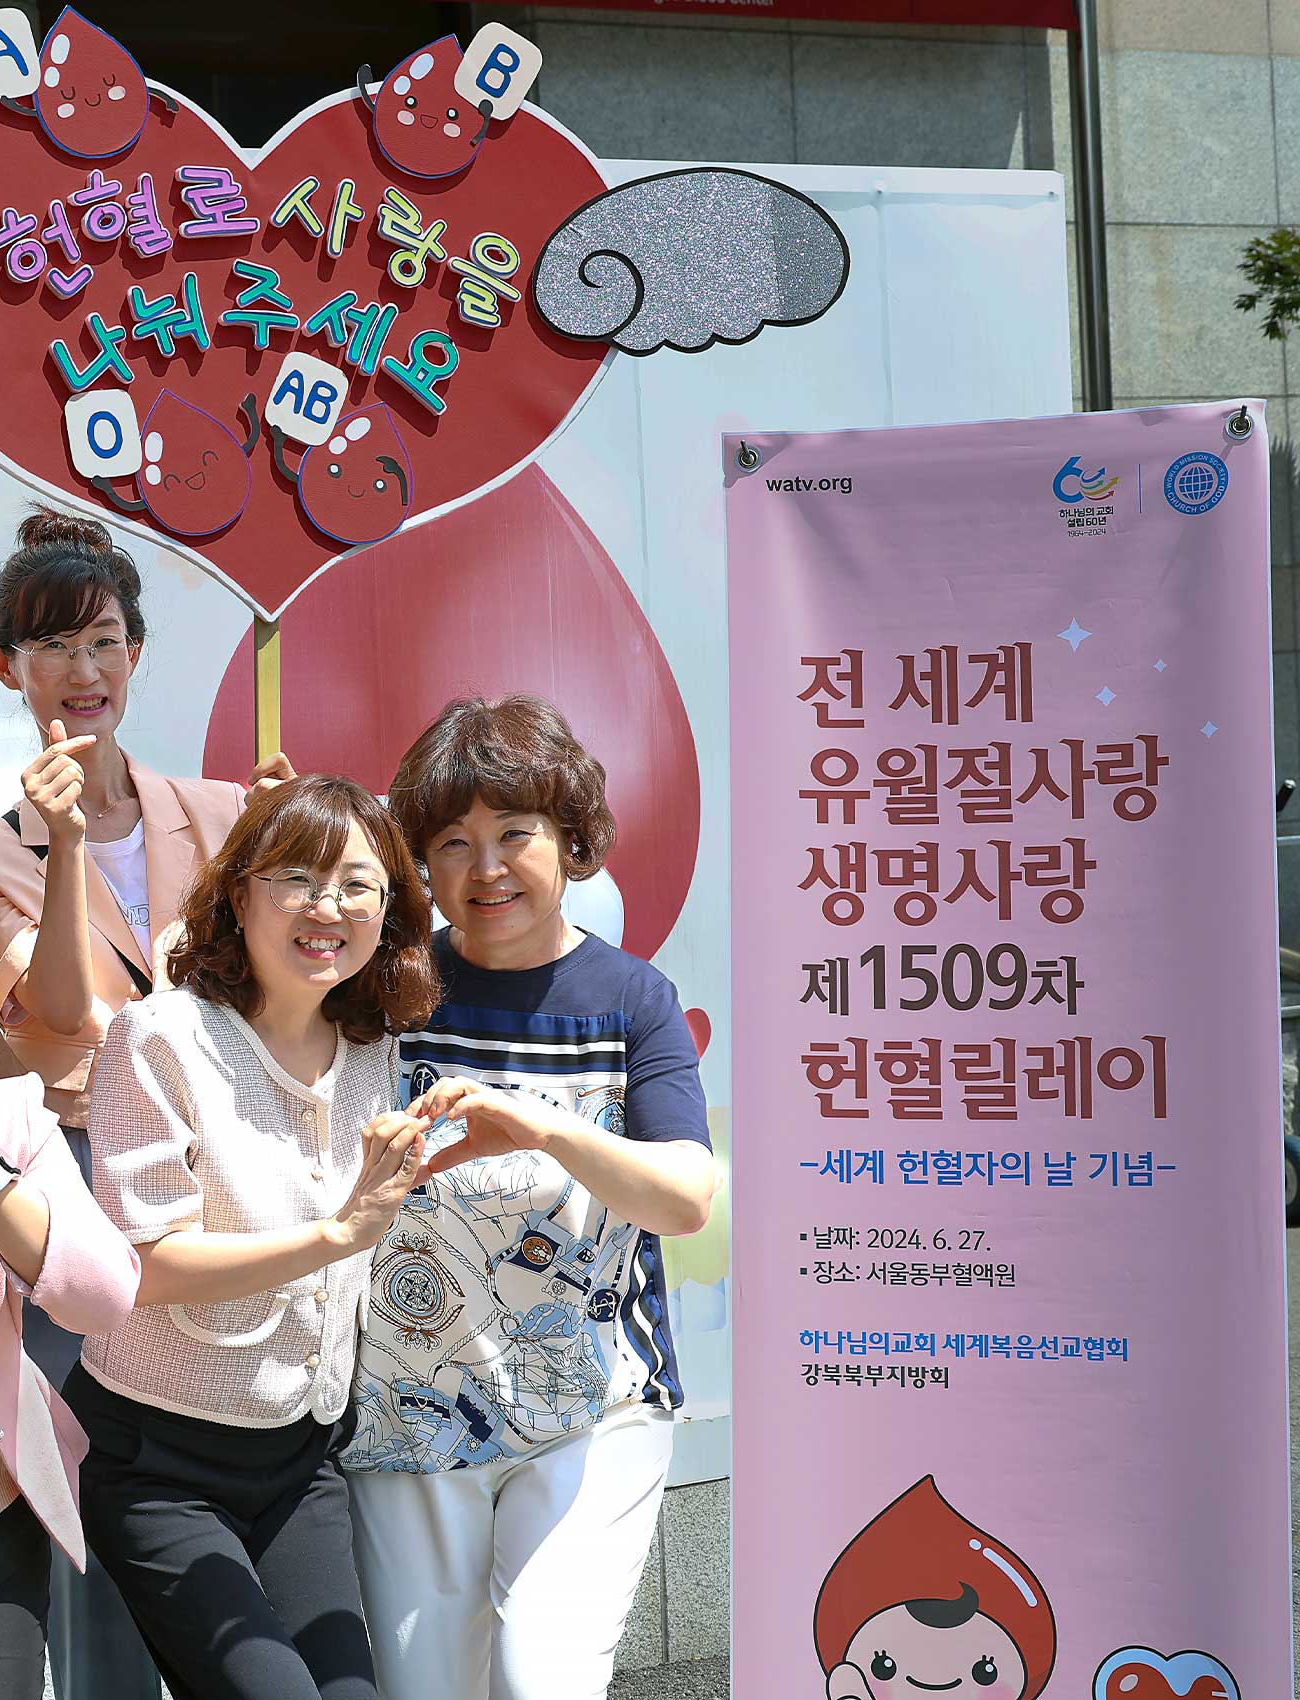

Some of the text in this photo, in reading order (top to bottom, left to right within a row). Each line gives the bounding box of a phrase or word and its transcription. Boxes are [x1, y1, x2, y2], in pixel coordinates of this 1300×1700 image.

[477, 43, 521, 98] B
[271, 176, 522, 329] 사랑을
[273, 369, 340, 425] AB
[765, 476, 852, 494] watv.org
[1165, 454, 1227, 489] WORLD MISSION SOCIETY
[1058, 505, 1114, 518] 하나님의 교회
[1167, 485, 1225, 513] CHURCH OF GOD
[797, 641, 1034, 729] 전 세계
[798, 734, 1171, 826] 유월절사랑
[797, 837, 1097, 927] 생명사랑
[799, 943, 1085, 1016] 제1509차
[800, 1036, 1168, 1121] 헌혈릴레이
[897, 1149, 1031, 1187] 헌혈자의
[1043, 1151, 1077, 1187] 날
[813, 1226, 991, 1252] 날짜: 2024. 6. 27.
[813, 1261, 1016, 1288] 장소: 서울동부혈액원
[799, 1330, 1129, 1361] 하나님의교회 세계복음선교협회
[800, 1363, 950, 1389] 강북북부지방회
